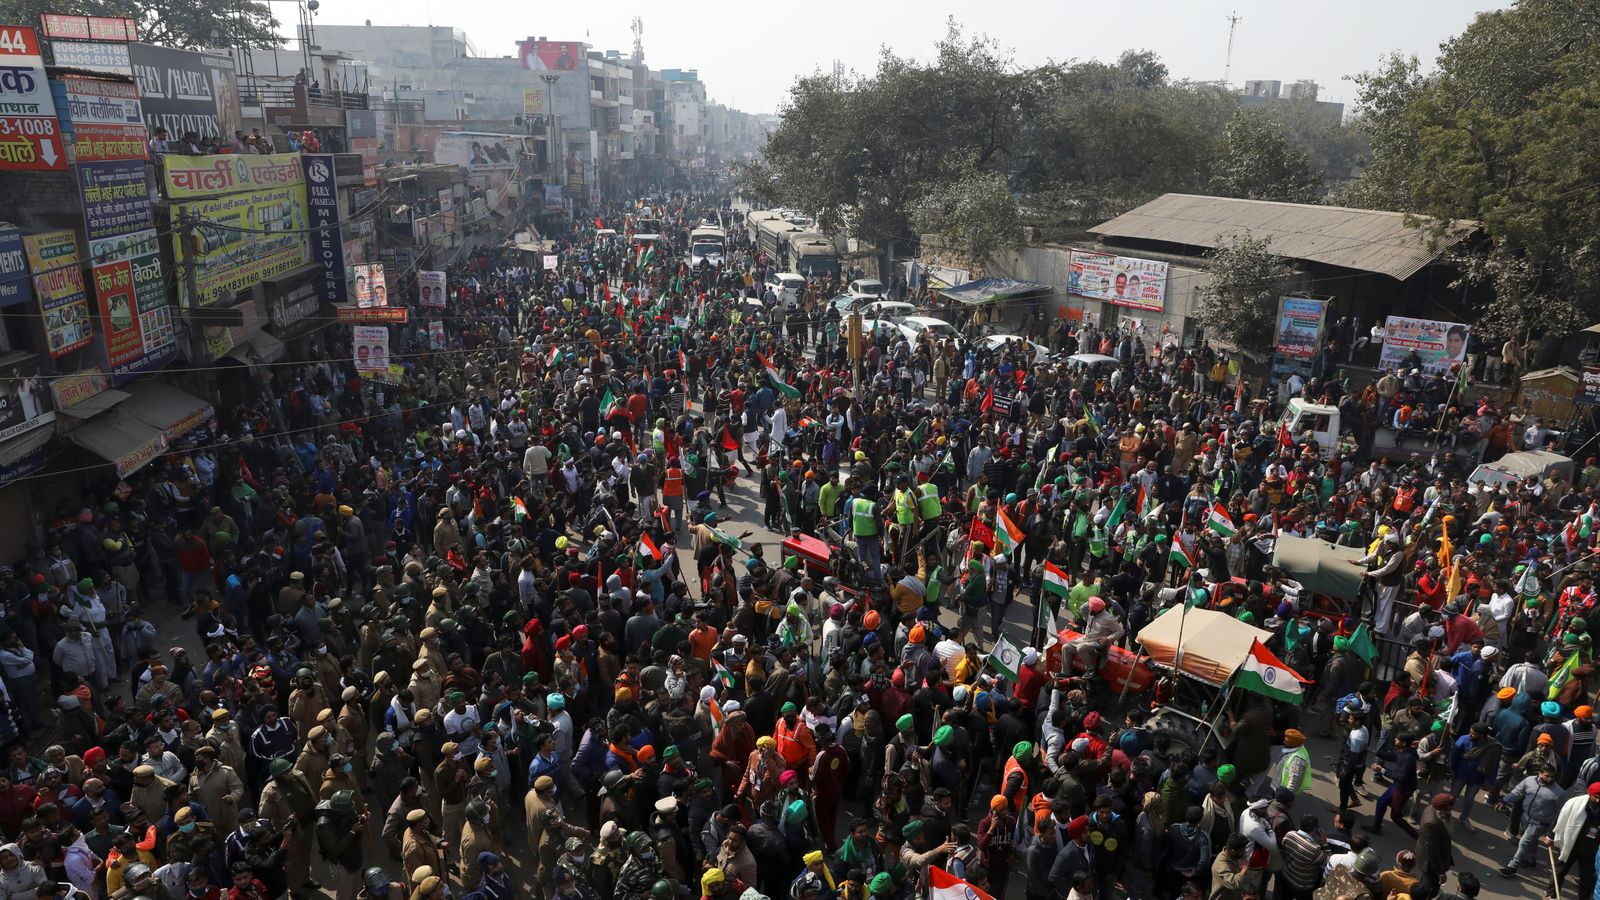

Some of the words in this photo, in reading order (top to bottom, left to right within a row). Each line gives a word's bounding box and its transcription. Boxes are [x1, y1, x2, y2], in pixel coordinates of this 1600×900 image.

[135, 64, 162, 98] RUBY
[164, 68, 212, 101] SHARMA
[89, 97, 123, 119] क्लीनिक
[146, 113, 221, 142] MAKEOVERS
[170, 160, 234, 191] चार्ली
[250, 157, 303, 186] एकेडमी
[262, 257, 302, 278] 9911861160
[318, 209, 337, 300] MAKEOVERS
[133, 257, 162, 283] बेकरी
